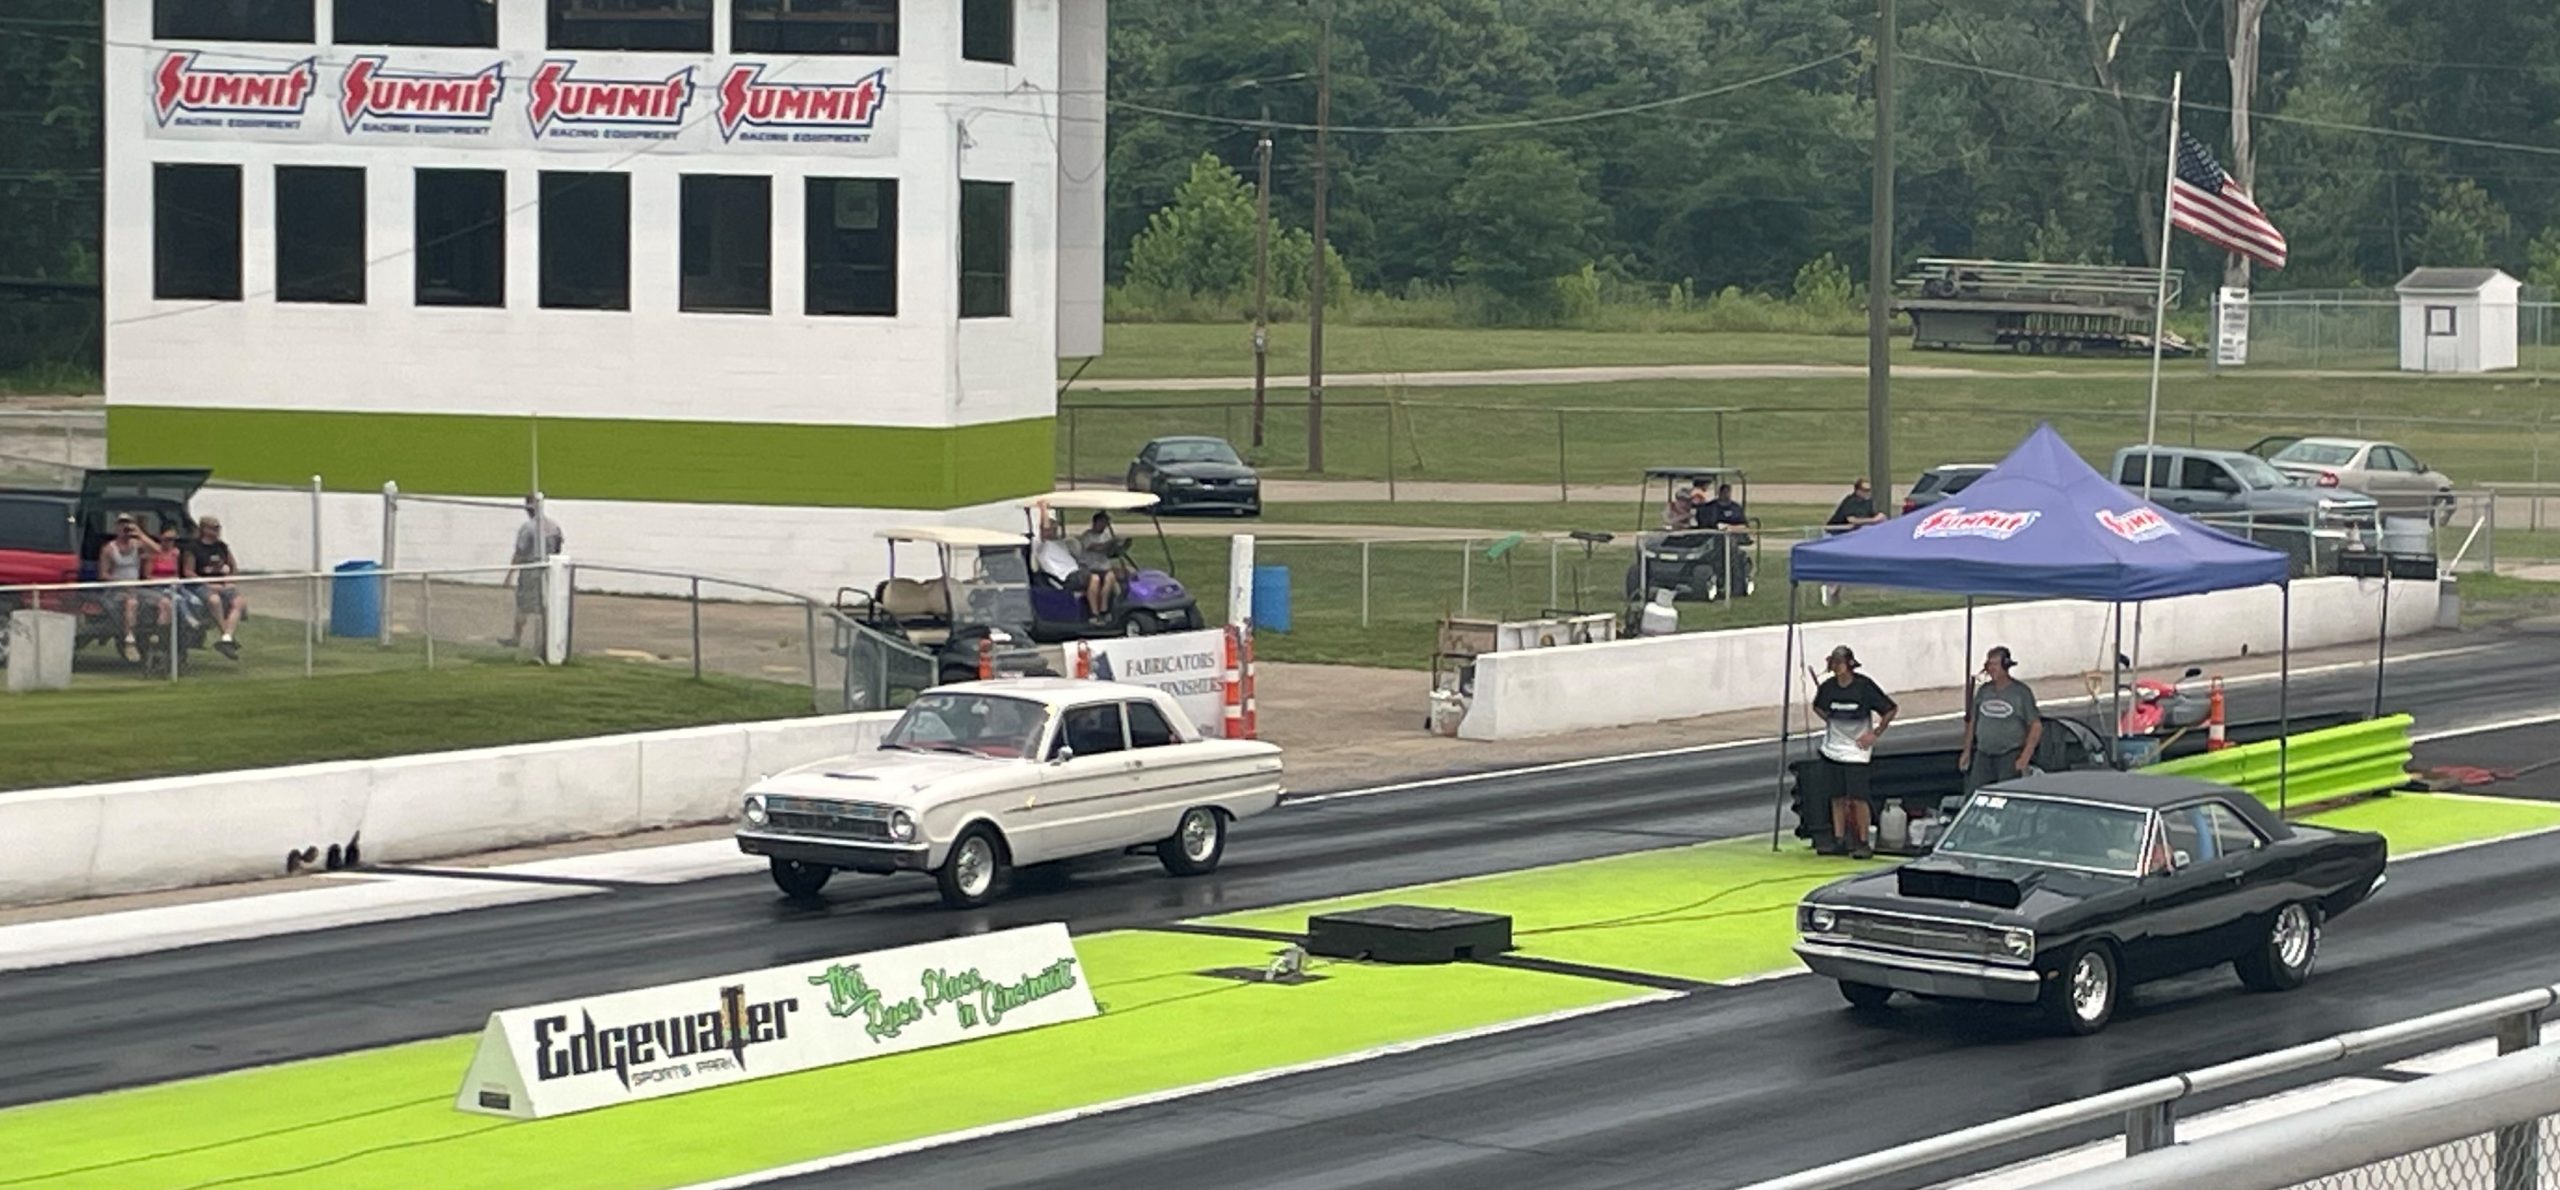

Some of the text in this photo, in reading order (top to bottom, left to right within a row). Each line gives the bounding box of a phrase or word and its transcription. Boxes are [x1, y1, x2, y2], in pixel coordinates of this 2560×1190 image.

[1126, 652, 1215, 677] FABRICATORS
[534, 984, 799, 1093] Edgewater
[631, 1057, 736, 1087] SPORTS PARK
